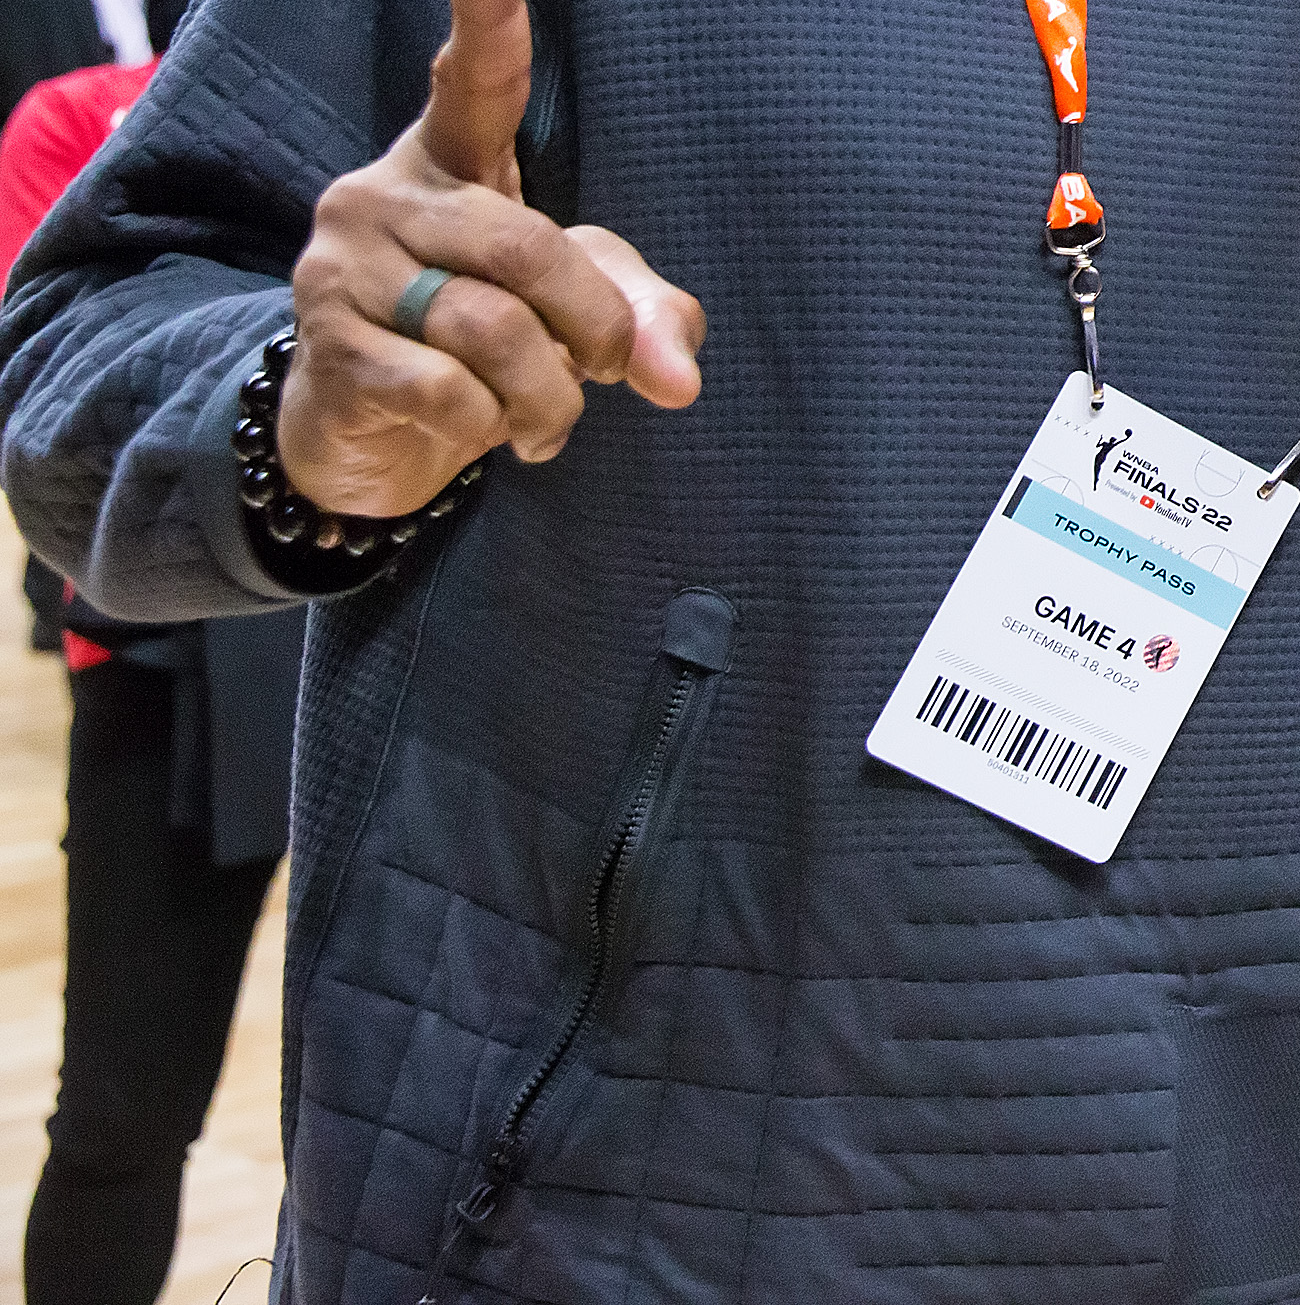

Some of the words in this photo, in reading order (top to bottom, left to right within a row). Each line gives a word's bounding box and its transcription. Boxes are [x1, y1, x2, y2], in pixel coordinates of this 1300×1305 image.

[1112, 459, 1234, 533] FINALS'22
[1122, 449, 1160, 476] WNBA
[1052, 511, 1139, 565] TROPHY
[1139, 558, 1198, 598] PASS
[1001, 614, 1082, 666] SEPTEMBER
[1080, 654, 1102, 679] 18,
[1101, 666, 1142, 694] 2022
[1033, 594, 1117, 652] GAME
[1116, 636, 1138, 662] 4
